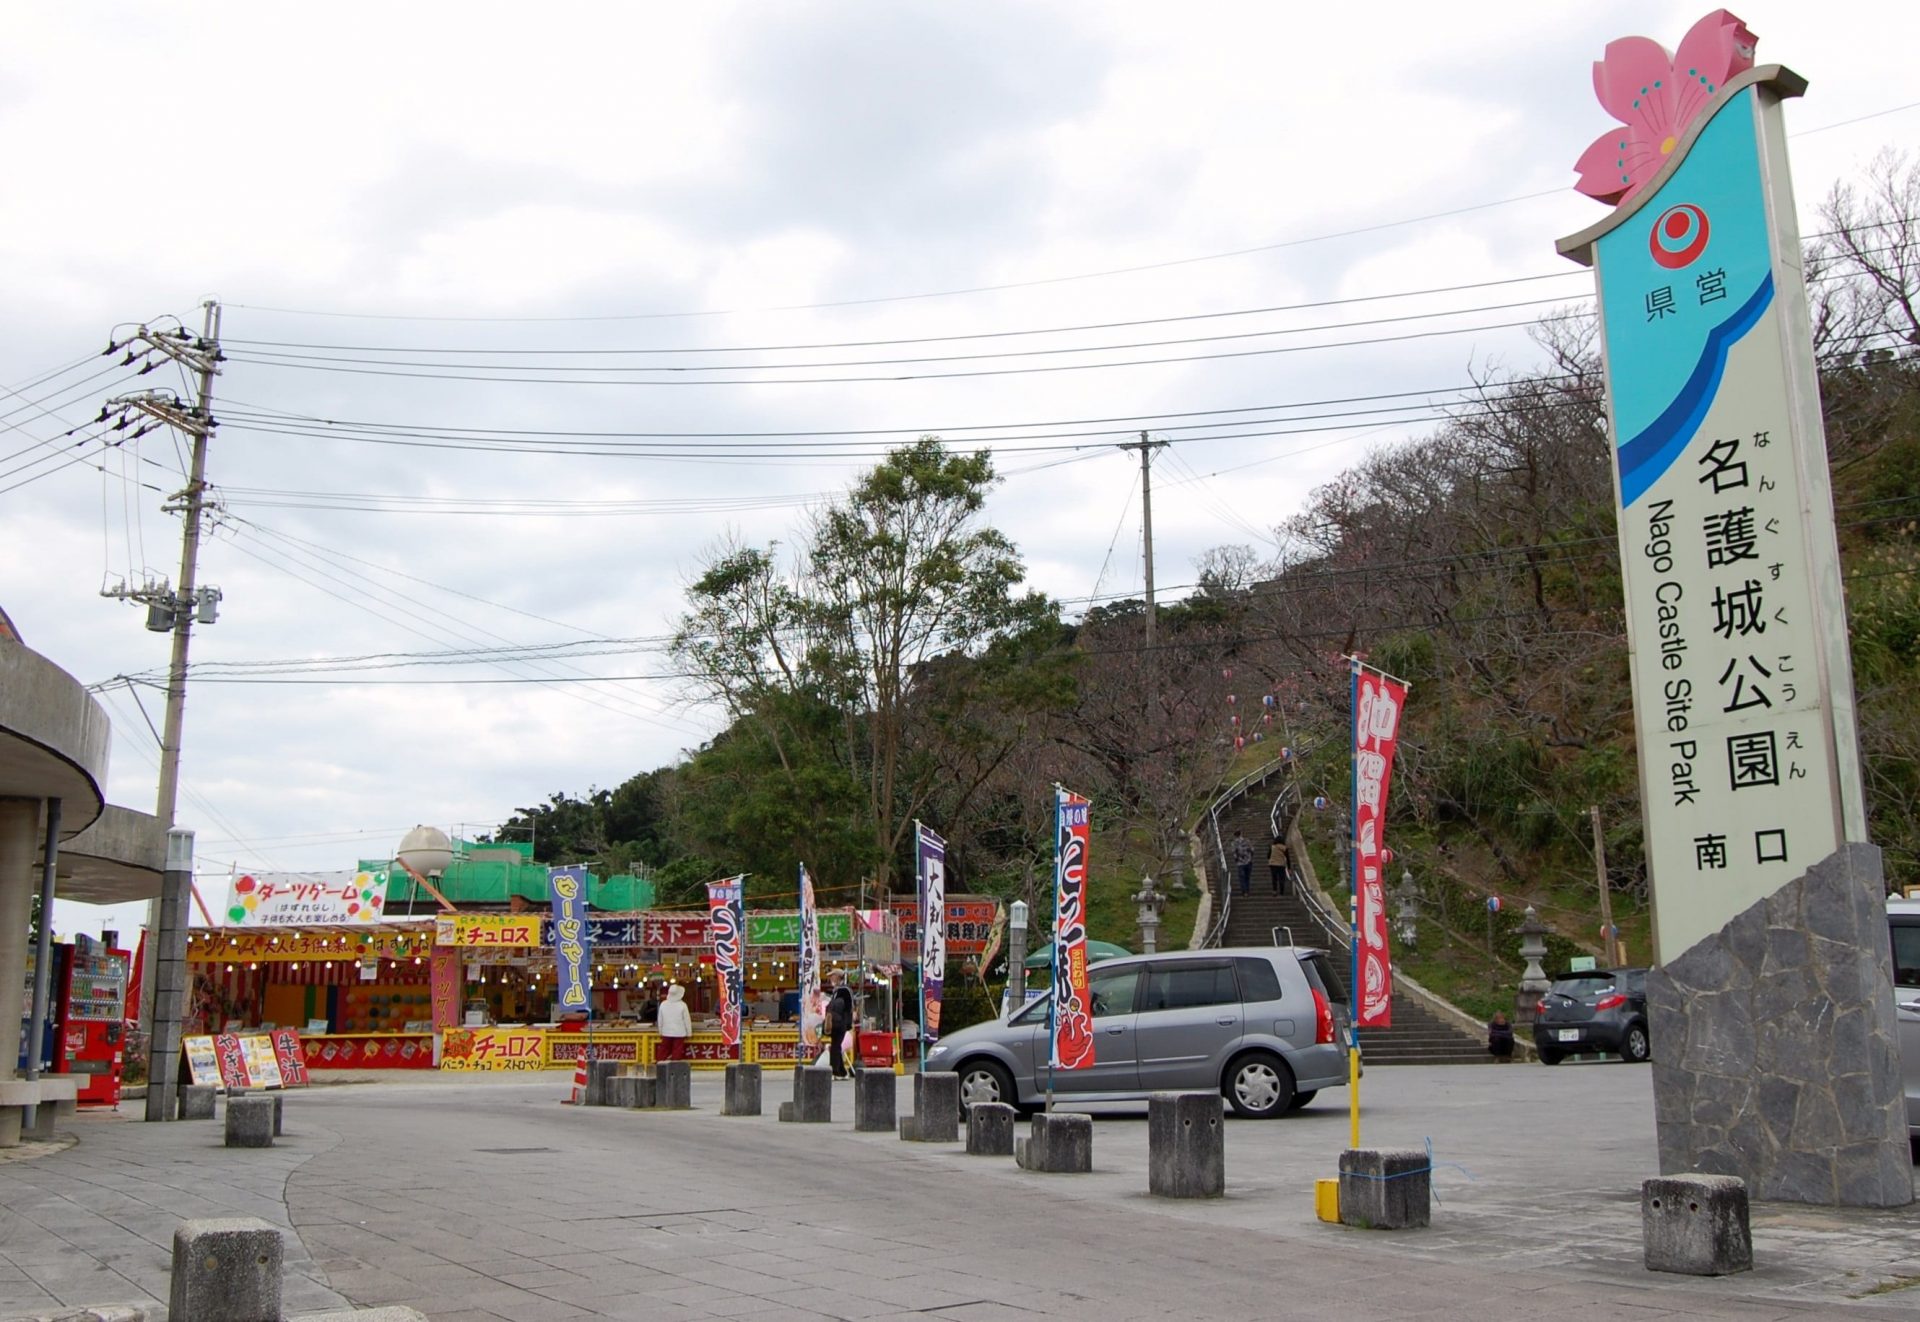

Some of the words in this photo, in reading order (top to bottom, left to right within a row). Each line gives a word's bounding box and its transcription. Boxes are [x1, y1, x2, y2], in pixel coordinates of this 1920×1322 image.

[1645, 268, 1727, 322] 県営
[1645, 499, 1675, 573] Nago
[1655, 581, 1687, 671] Castle
[1698, 439, 1780, 791] 名護城公園
[1664, 679, 1692, 732] Site
[1670, 740, 1701, 806] Park
[1694, 828, 1787, 871] 南口
[257, 883, 359, 902] ダーツゲーム
[467, 927, 530, 944] チュロス
[752, 917, 845, 939] ソーキば
[280, 1032, 305, 1083] 牛汁
[475, 1035, 542, 1060] チュロス
